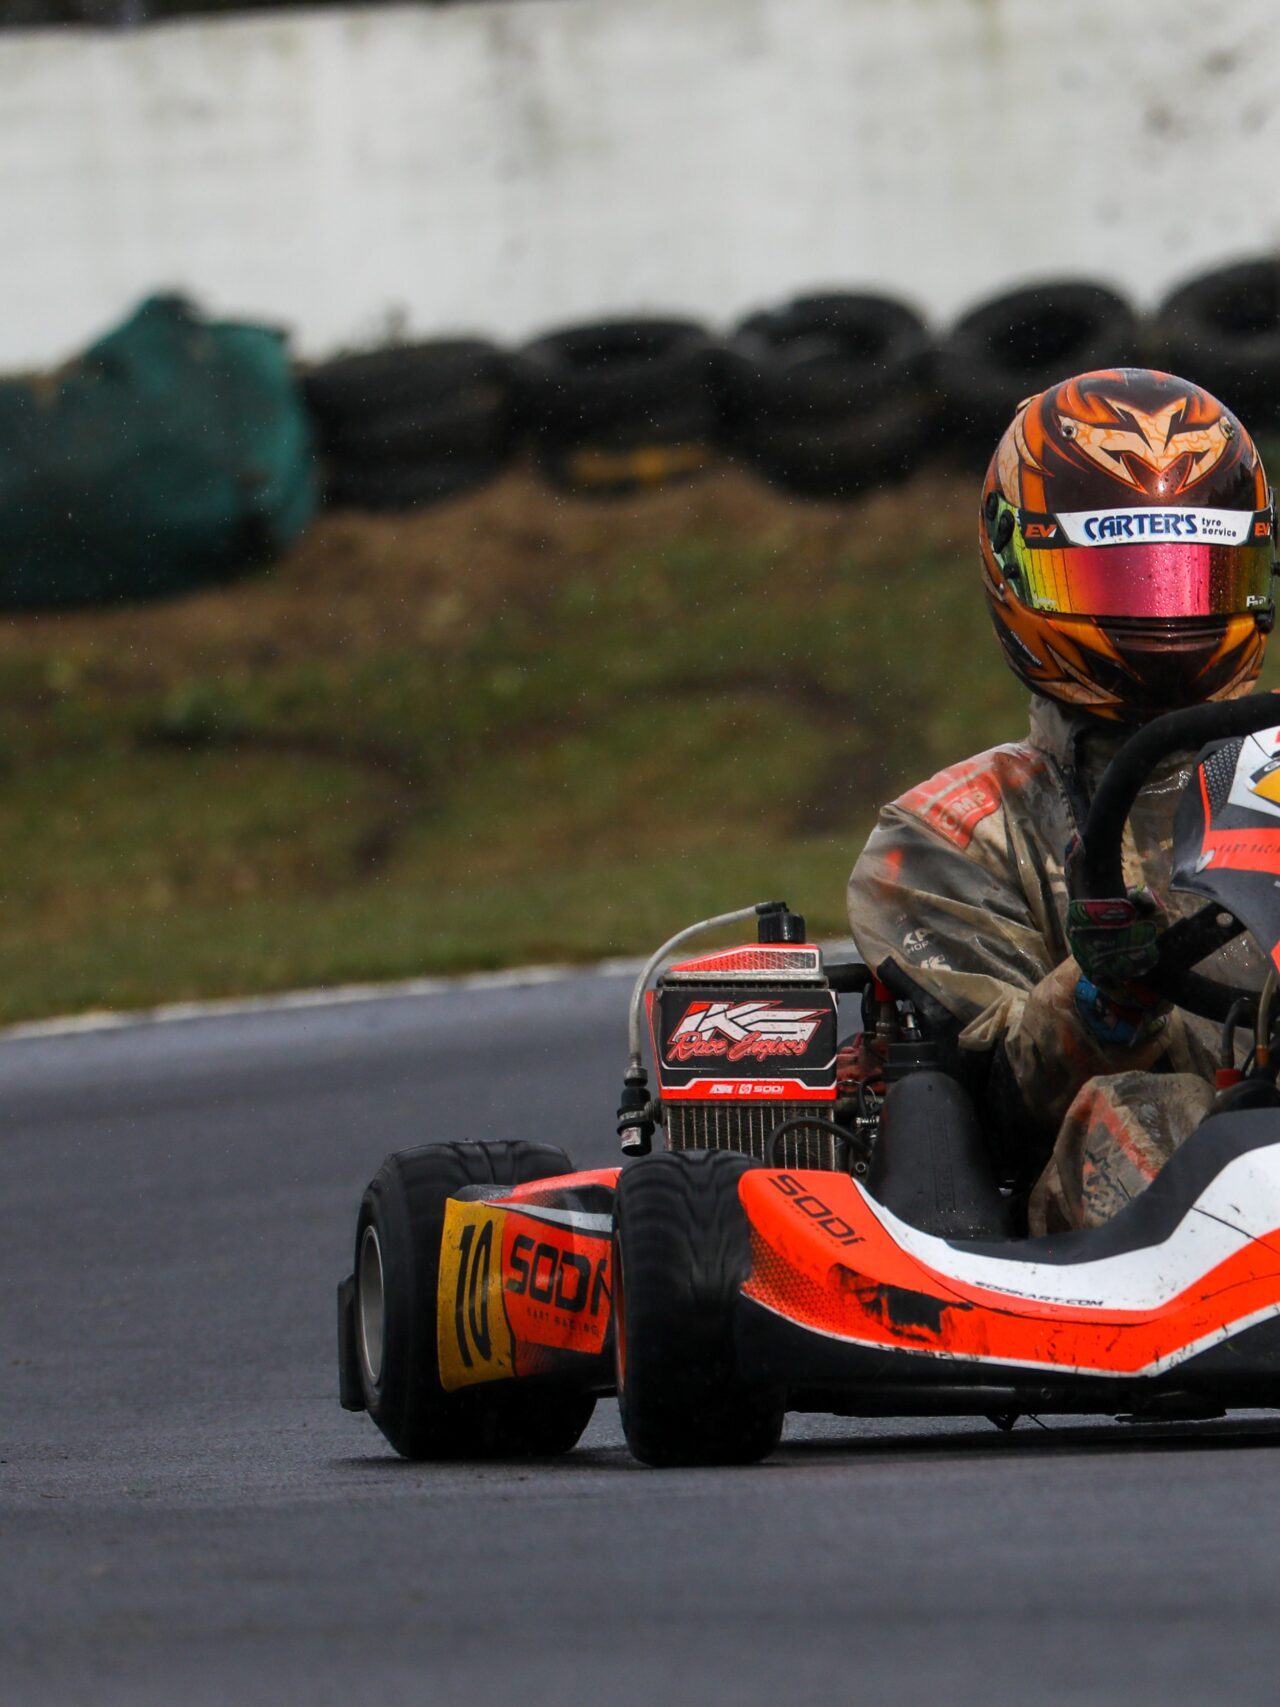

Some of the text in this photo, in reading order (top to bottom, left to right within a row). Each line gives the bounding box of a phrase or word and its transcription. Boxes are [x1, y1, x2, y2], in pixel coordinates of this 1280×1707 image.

[1084, 513, 1198, 541] CARTER'S
[1202, 517, 1222, 527] tyre
[1202, 527, 1237, 538] service
[666, 1030, 728, 1062] Race
[455, 1220, 493, 1368] 10
[526, 1306, 600, 1337] KART RACING
